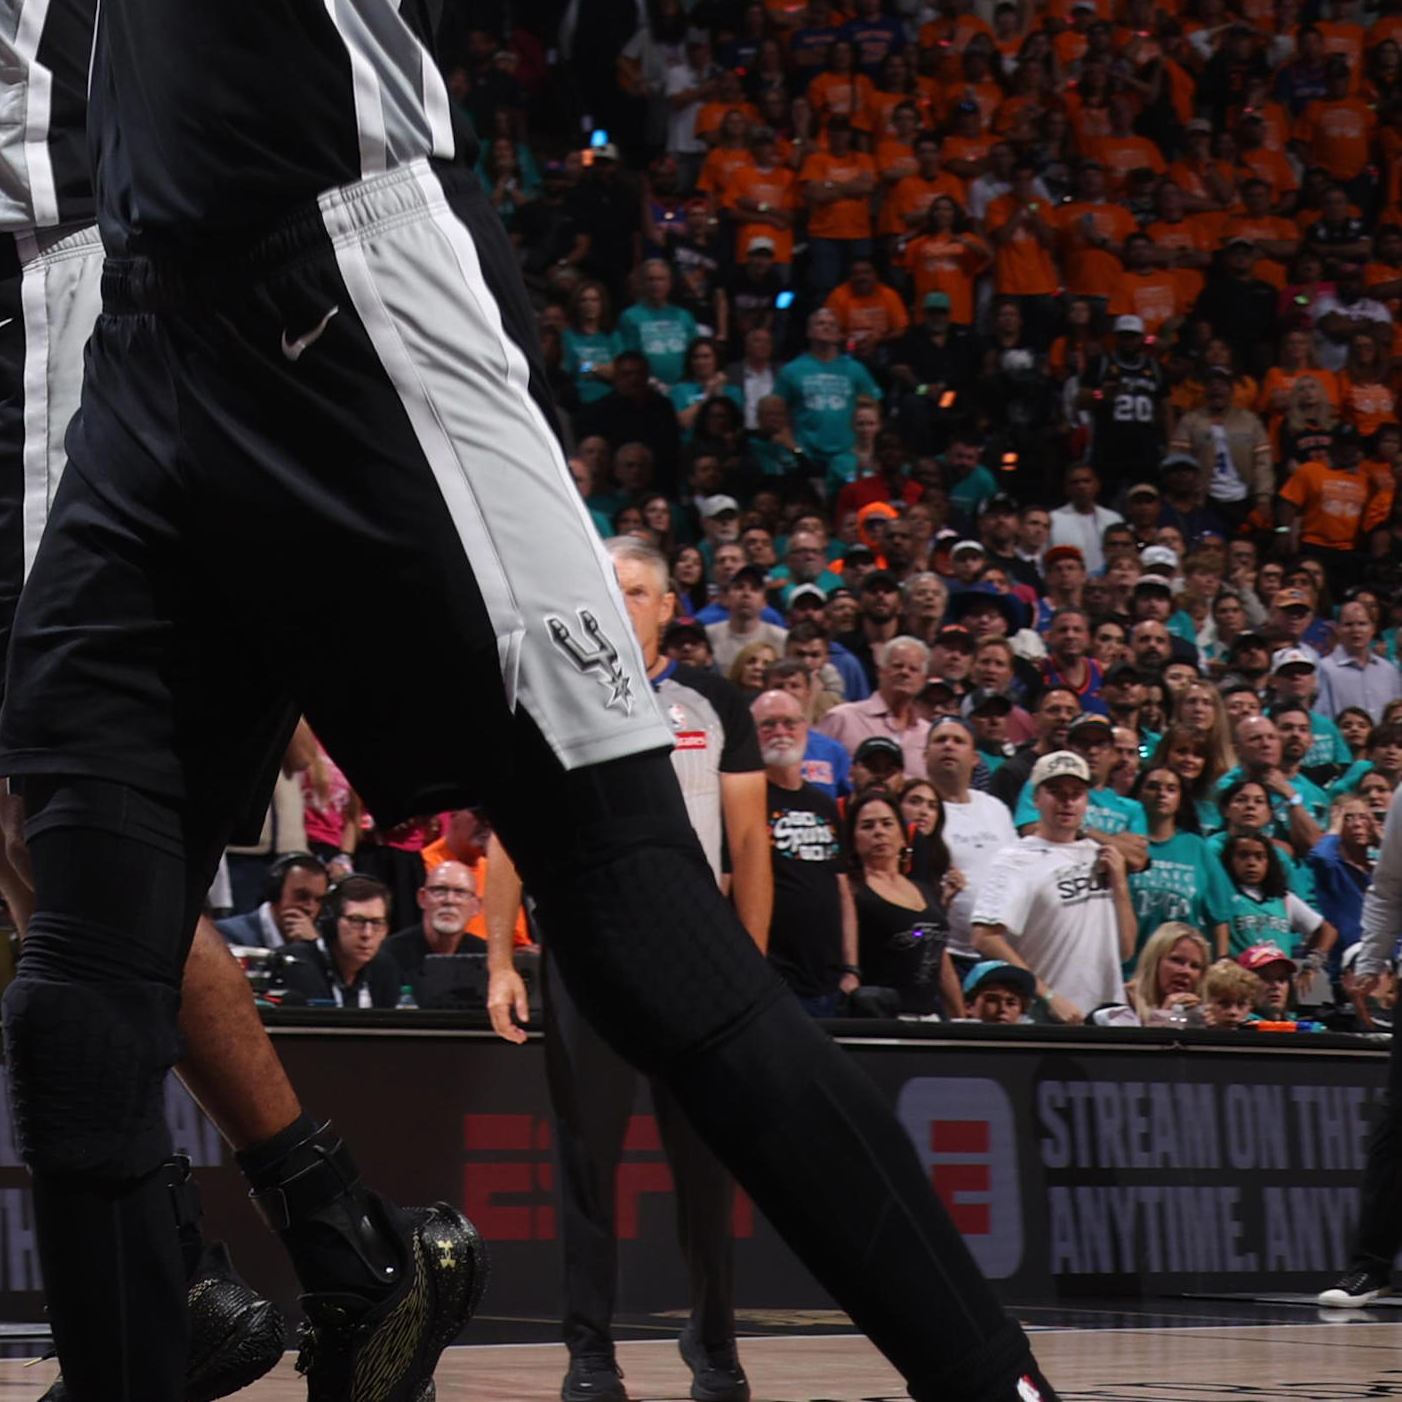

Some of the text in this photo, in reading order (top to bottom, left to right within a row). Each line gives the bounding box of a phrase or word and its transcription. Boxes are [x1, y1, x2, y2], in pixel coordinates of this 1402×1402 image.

[1038, 1080, 1216, 1171] STREAM
[1224, 1082, 1284, 1170] ON
[1290, 1085, 1372, 1171] THE
[1049, 1185, 1257, 1275] ANYTIME.
